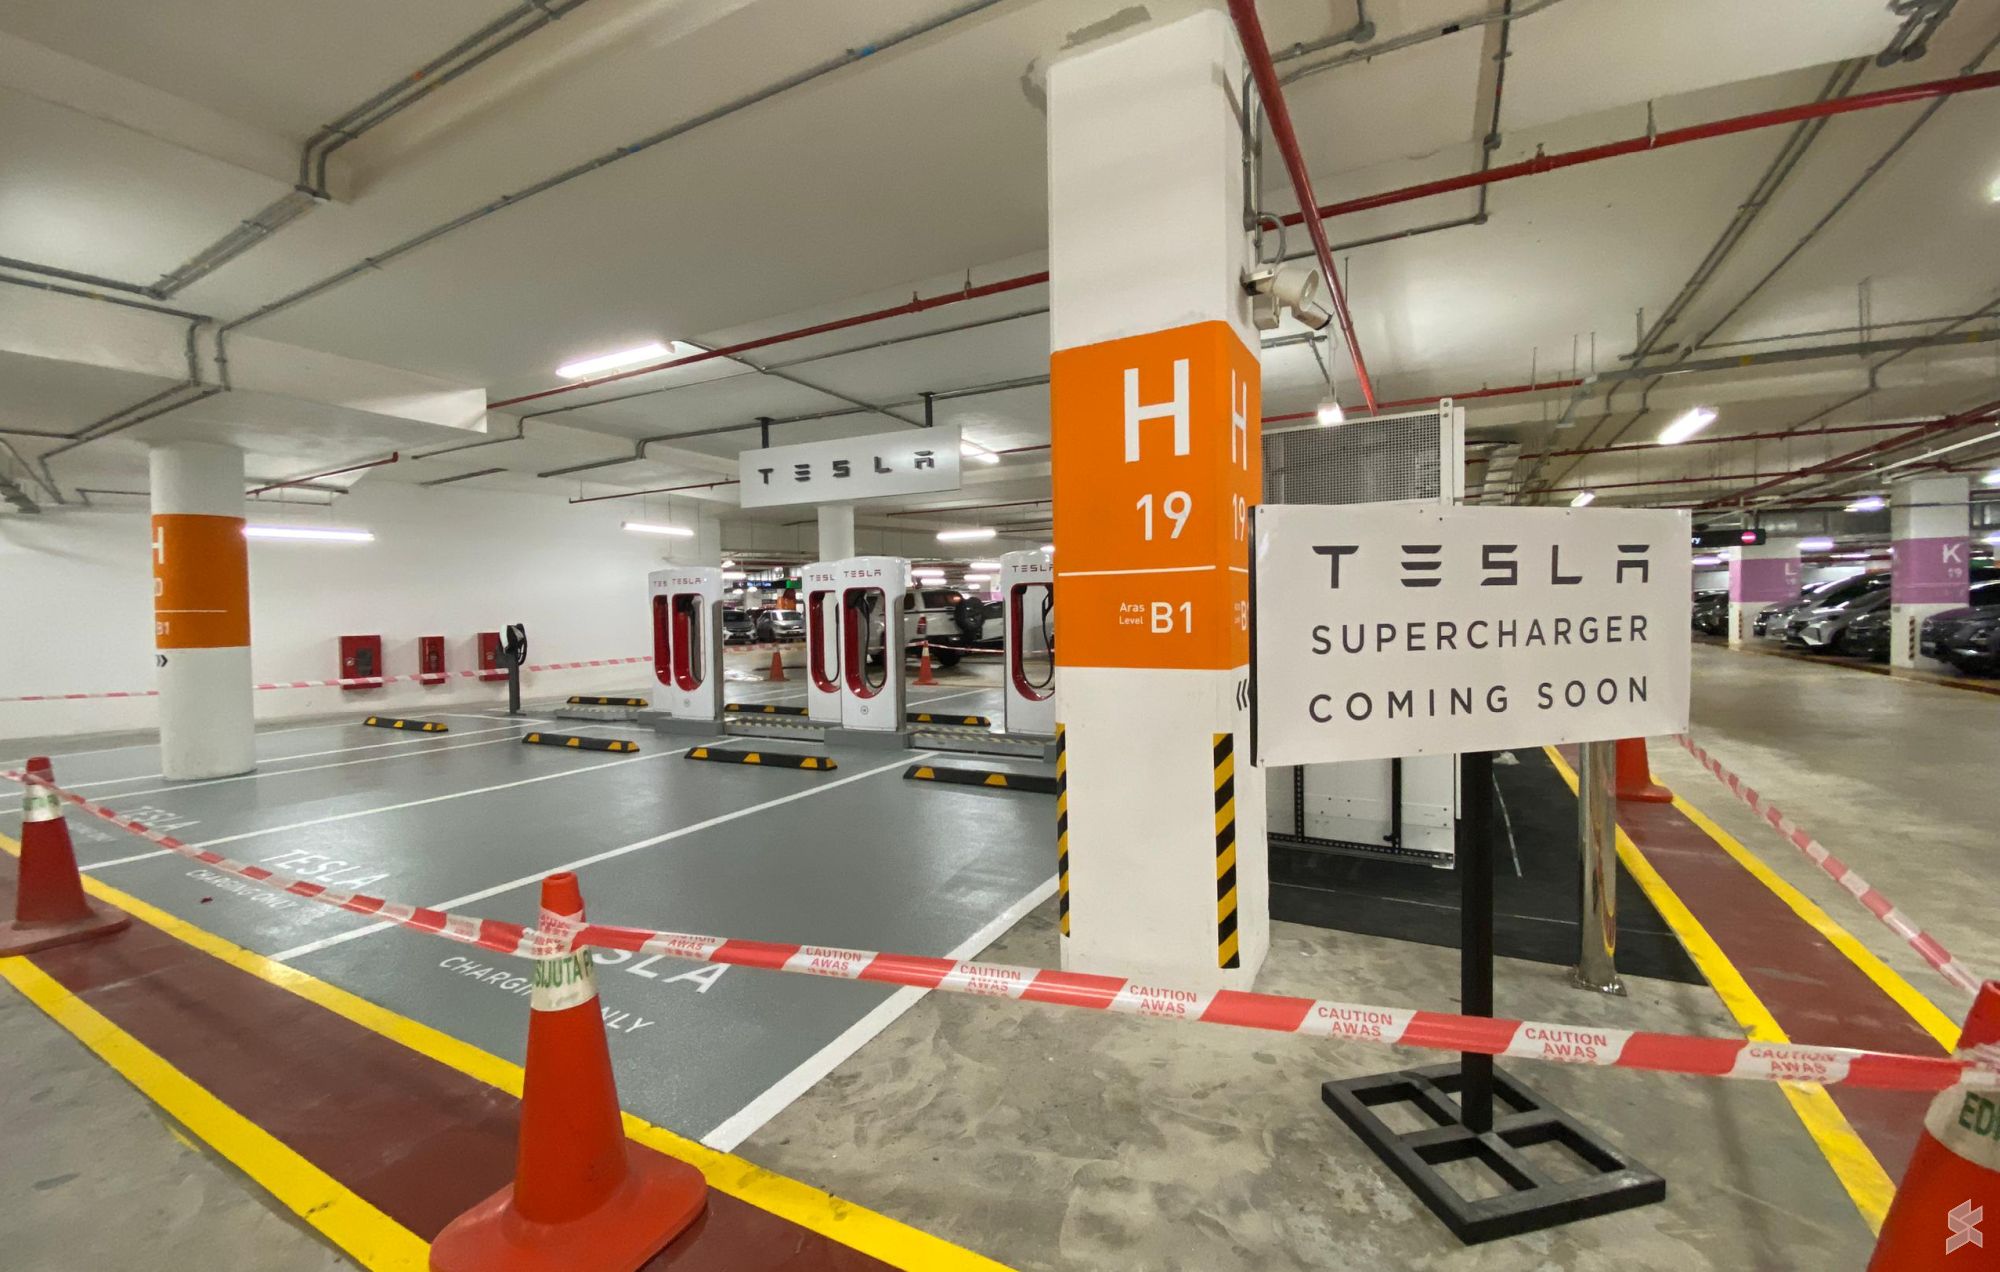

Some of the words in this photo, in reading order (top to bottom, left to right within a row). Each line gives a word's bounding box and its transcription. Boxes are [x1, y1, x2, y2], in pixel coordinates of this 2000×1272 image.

[1124, 358, 1190, 464] H
[1231, 368, 1247, 471] H
[757, 450, 936, 485] TESLA
[1136, 490, 1193, 541] 19
[1232, 493, 1246, 542] 19
[1942, 543, 1962, 564] K
[843, 569, 882, 578] TESLA
[1311, 544, 1650, 589] TESLA
[1784, 562, 1798, 576] L
[672, 577, 702, 585] TESLA
[1119, 602, 1145, 613] Aras
[1118, 615, 1144, 625] Level
[1151, 601, 1193, 634] B1
[1311, 615, 1648, 655] SUPERCHARGER
[1309, 684, 1508, 723] COMING
[1538, 675, 1648, 710] SOON
[260, 849, 391, 890] TESLA
[806, 947, 863, 962] CAUTION
[811, 957, 849, 971] AWAS
[439, 956, 532, 997] CHARGI
[960, 964, 1021, 980] CAUTION
[1130, 984, 1197, 1003] CAUTION
[1140, 998, 1186, 1014] AWAS
[1318, 1006, 1393, 1026] CAUTION
[1332, 1021, 1381, 1037] AWAS
[1525, 1028, 1607, 1047] CAUTION
[1543, 1042, 1598, 1059] AWAS
[1749, 1048, 1836, 1062] CAUTION
[1770, 1060, 1827, 1074] AWAS
